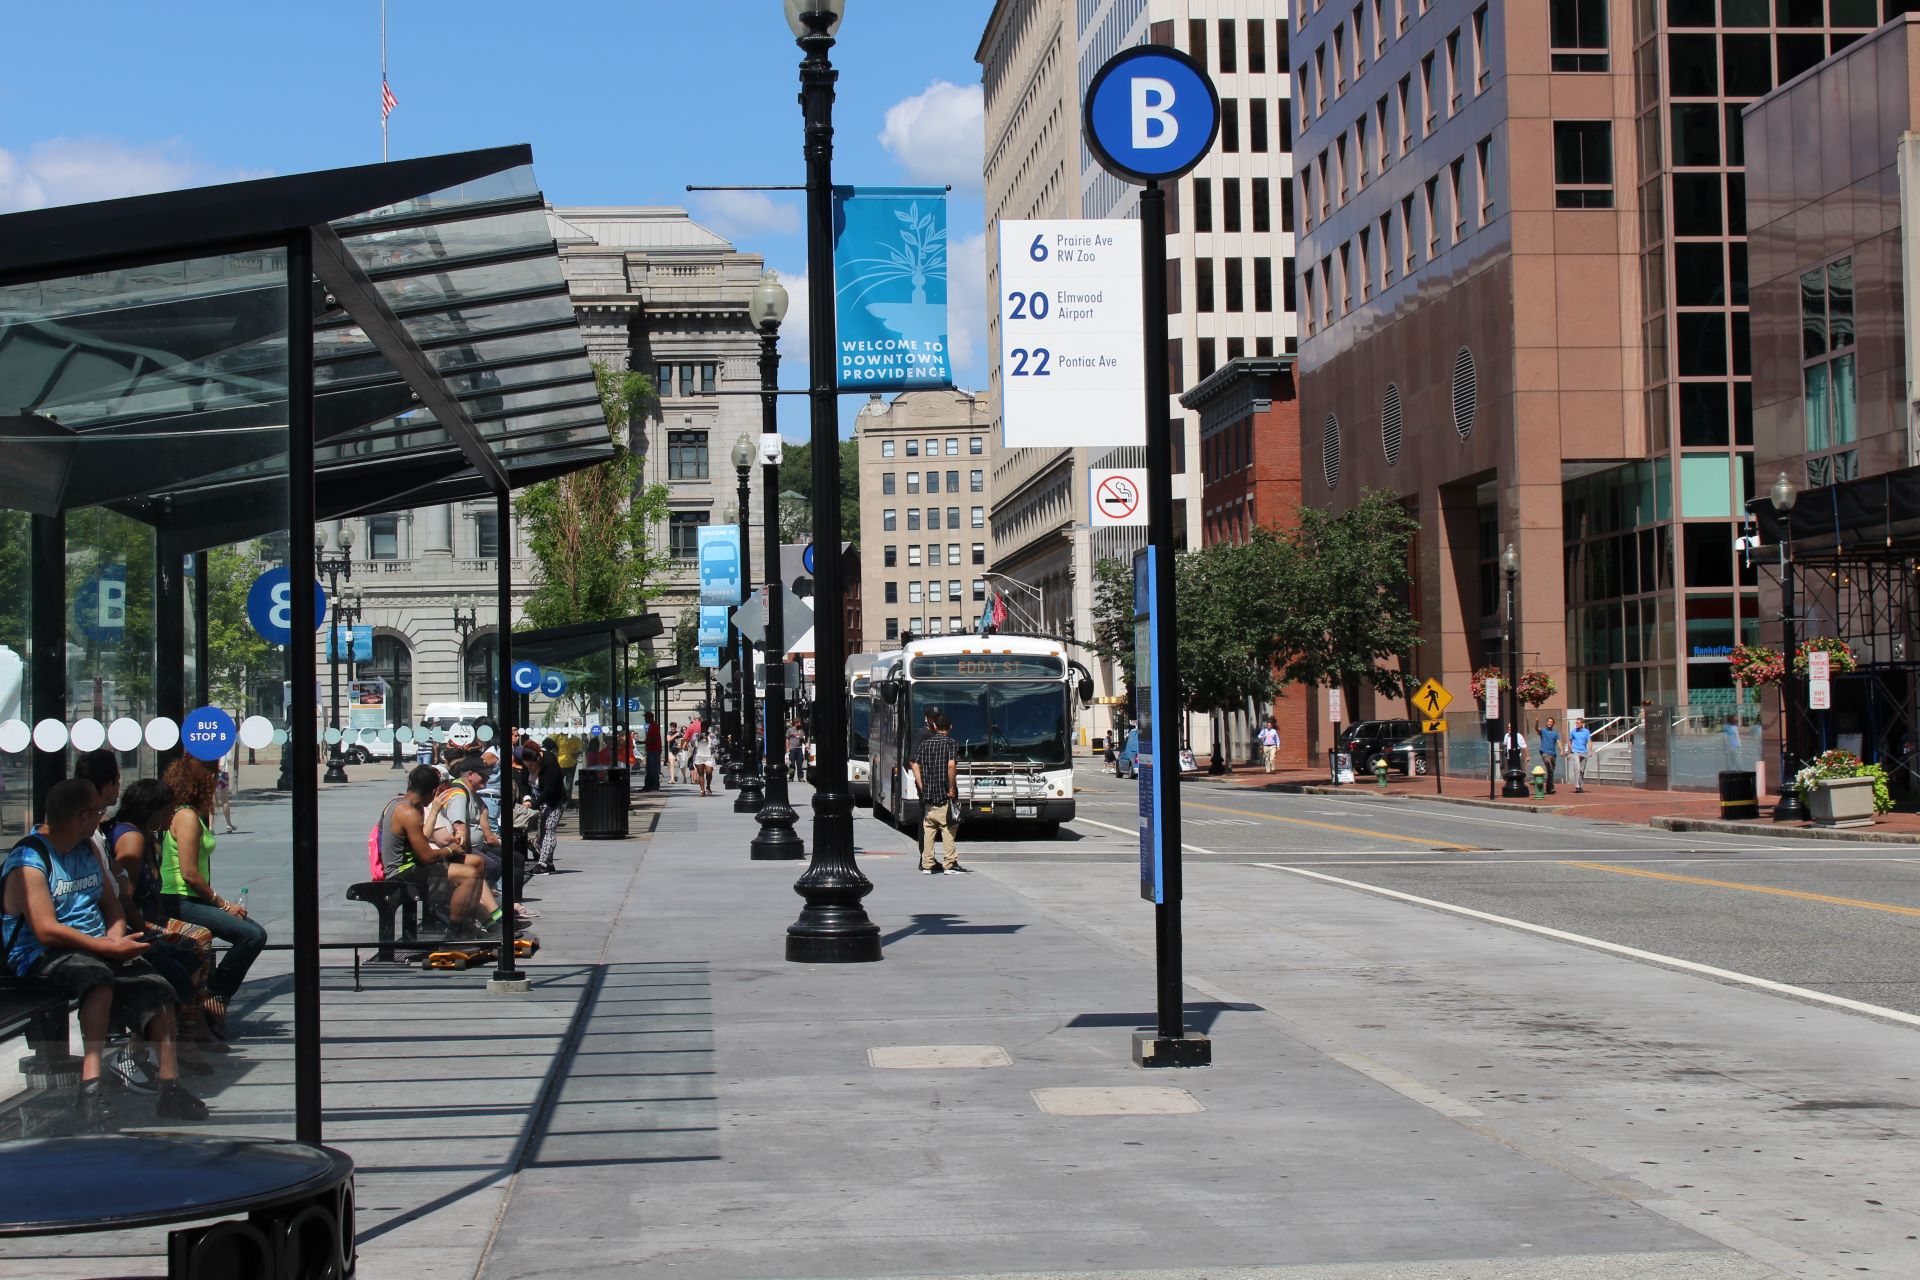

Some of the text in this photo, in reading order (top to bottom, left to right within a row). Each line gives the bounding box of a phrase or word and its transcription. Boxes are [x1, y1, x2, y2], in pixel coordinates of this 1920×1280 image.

[1131, 77, 1178, 149] B
[1057, 234, 1113, 246] Prairie Ave
[1030, 234, 1049, 262] 6
[1057, 250, 1096, 262] RW Zoo
[1057, 291, 1103, 303] Elmwood
[1008, 291, 1049, 320] 20
[1058, 307, 1094, 322] Airport
[842, 339, 943, 353] WELCOME TO
[842, 353, 944, 366] DOWNTOWN
[1010, 348, 1051, 376] 22
[1059, 355, 1117, 367] Pontiac Ave
[842, 367, 946, 380] PROVIDENCE
[1694, 646, 1713, 654] Bank
[1714, 646, 1721, 654] of
[958, 661, 997, 674] EDDY
[1003, 661, 1022, 674] ST
[515, 667, 532, 688] C
[198, 721, 218, 730] BUS
[190, 733, 227, 741] STOP B
